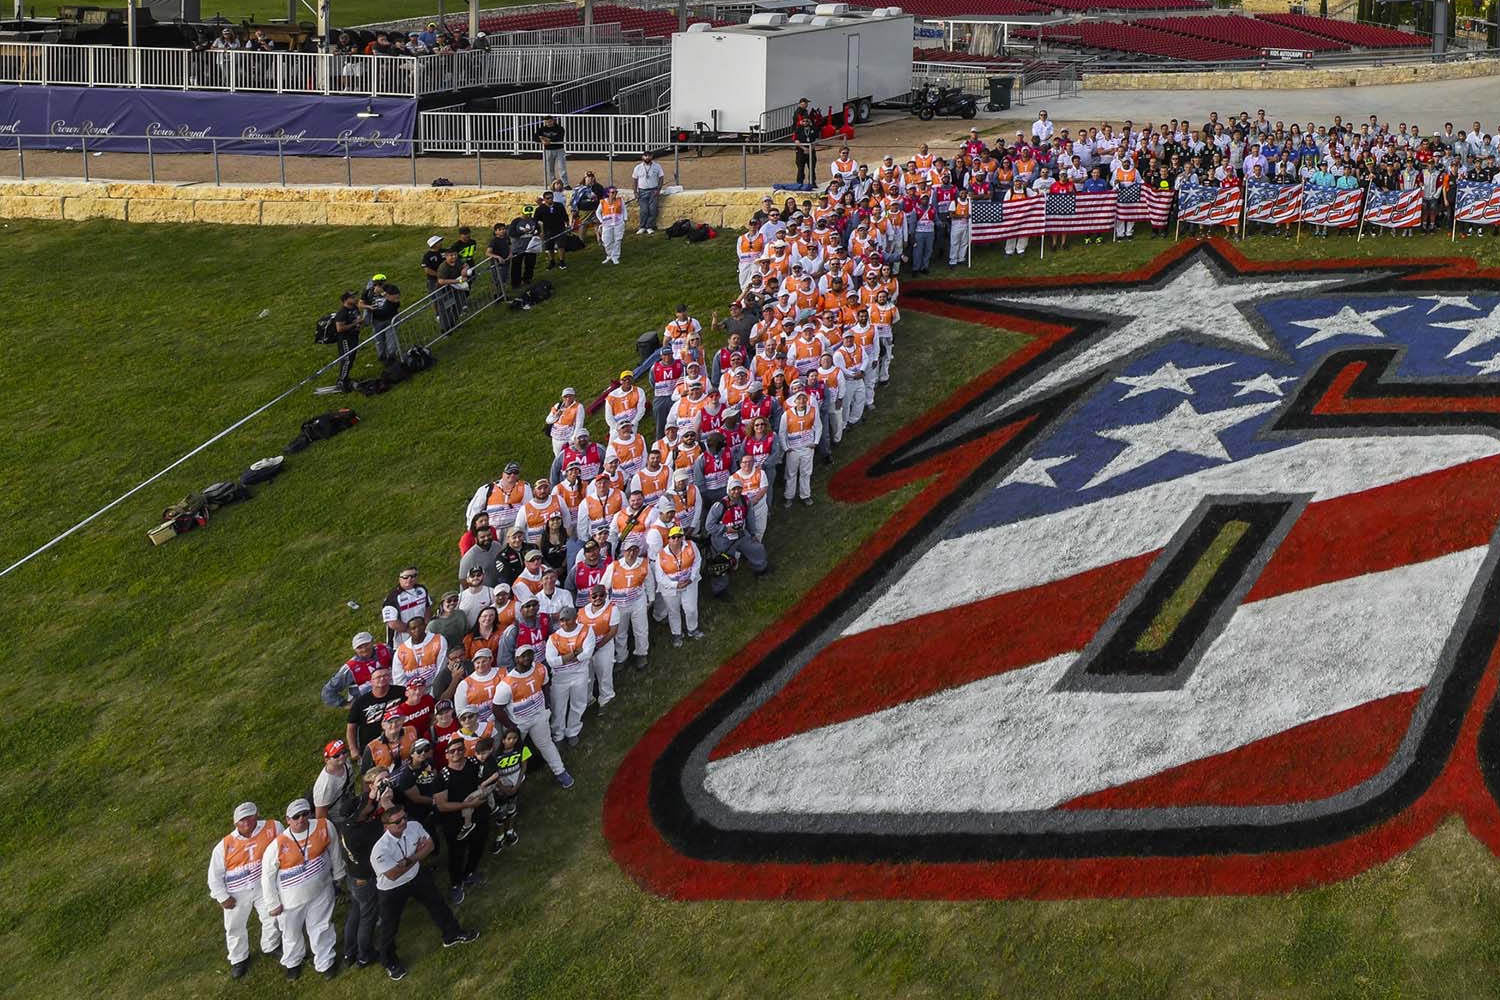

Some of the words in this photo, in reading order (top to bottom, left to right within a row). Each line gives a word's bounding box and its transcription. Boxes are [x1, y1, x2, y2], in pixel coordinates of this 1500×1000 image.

[0, 120, 20, 133] yal
[51, 120, 80, 135] Crown
[82, 120, 115, 136] Royal
[146, 122, 176, 136] Crown
[177, 124, 212, 141] Royal
[664, 370, 672, 379] M
[750, 408, 760, 417] M
[711, 418, 720, 428] M
[732, 434, 740, 445] M
[753, 445, 762, 454] M
[576, 455, 586, 465] M
[714, 459, 722, 471] M
[735, 510, 742, 520] M
[588, 574, 600, 586] M
[531, 630, 542, 643] M
[498, 754, 520, 768] 46
